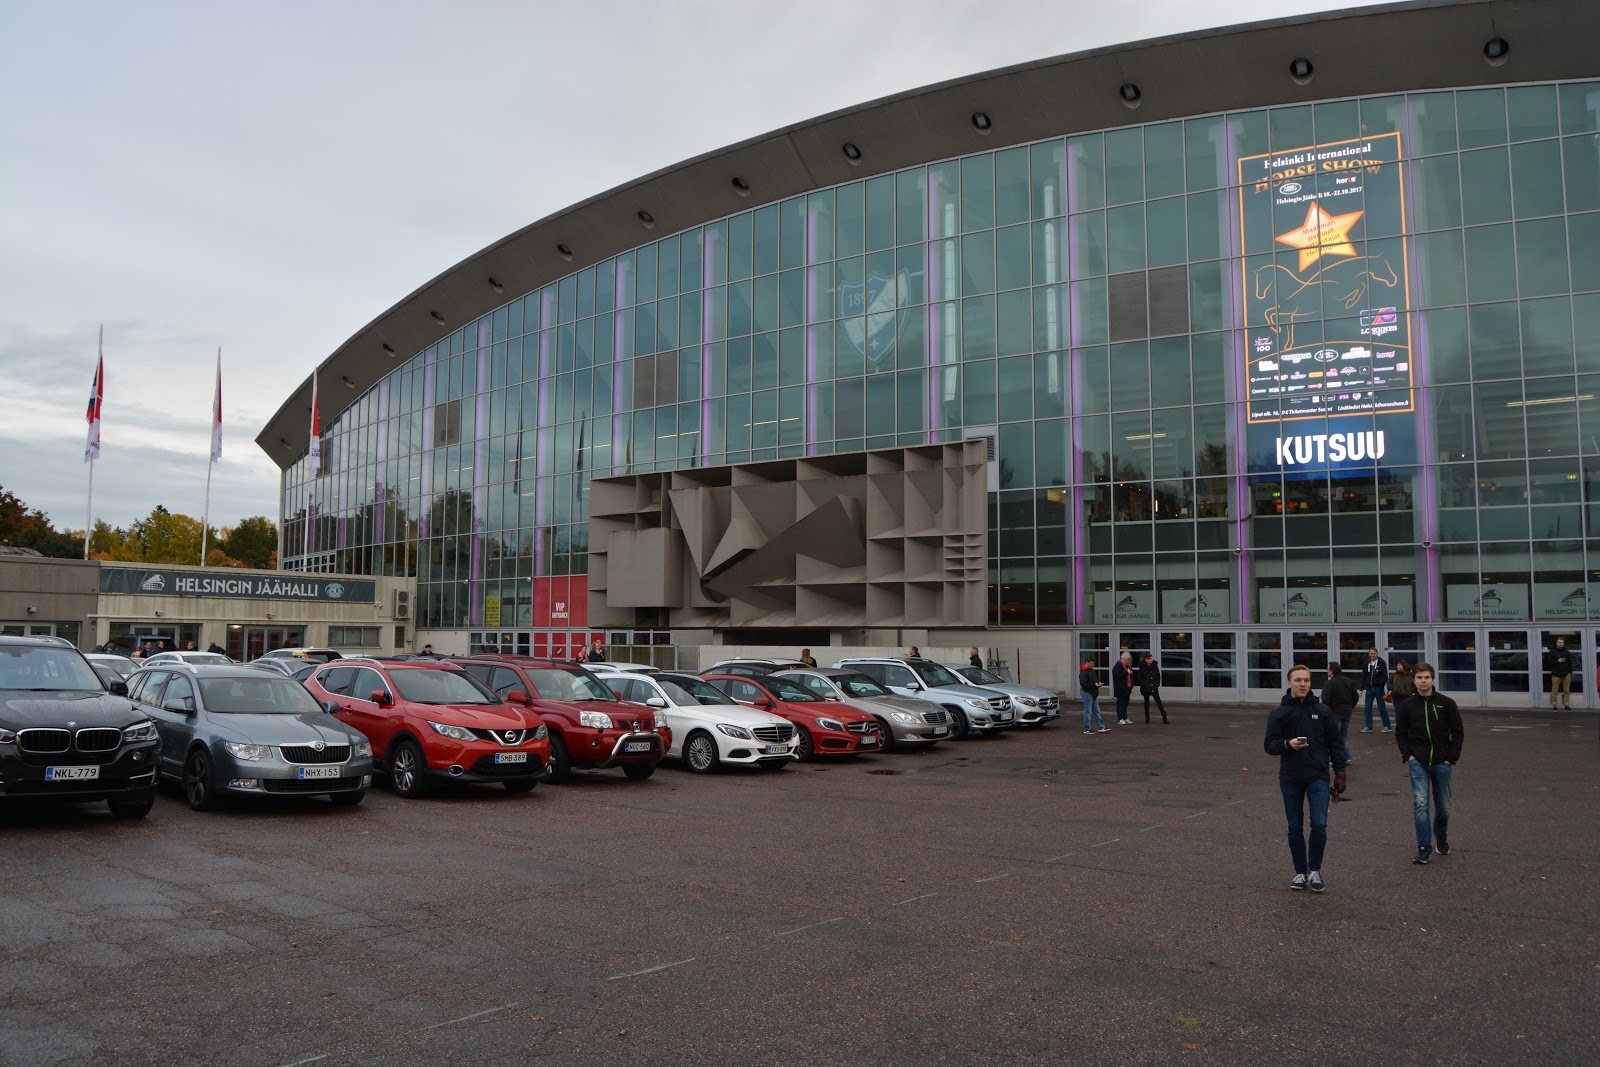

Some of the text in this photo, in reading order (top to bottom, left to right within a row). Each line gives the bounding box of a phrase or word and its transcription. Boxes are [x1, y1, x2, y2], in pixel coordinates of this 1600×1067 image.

[1264, 154, 1304, 169] Helsinki
[1254, 159, 1384, 194] HORSE SHOW
[1276, 196, 1302, 205] Helsingin
[1302, 193, 1323, 202] Jäähali
[848, 290, 876, 306] 1897
[1276, 430, 1385, 465] KUTSUU
[175, 577, 252, 594] HELSINGIN
[256, 579, 319, 597] JÄÄHALLI
[555, 602, 565, 611] VIP
[54, 768, 97, 778] NKL-779
[305, 768, 339, 777] NHX-153
